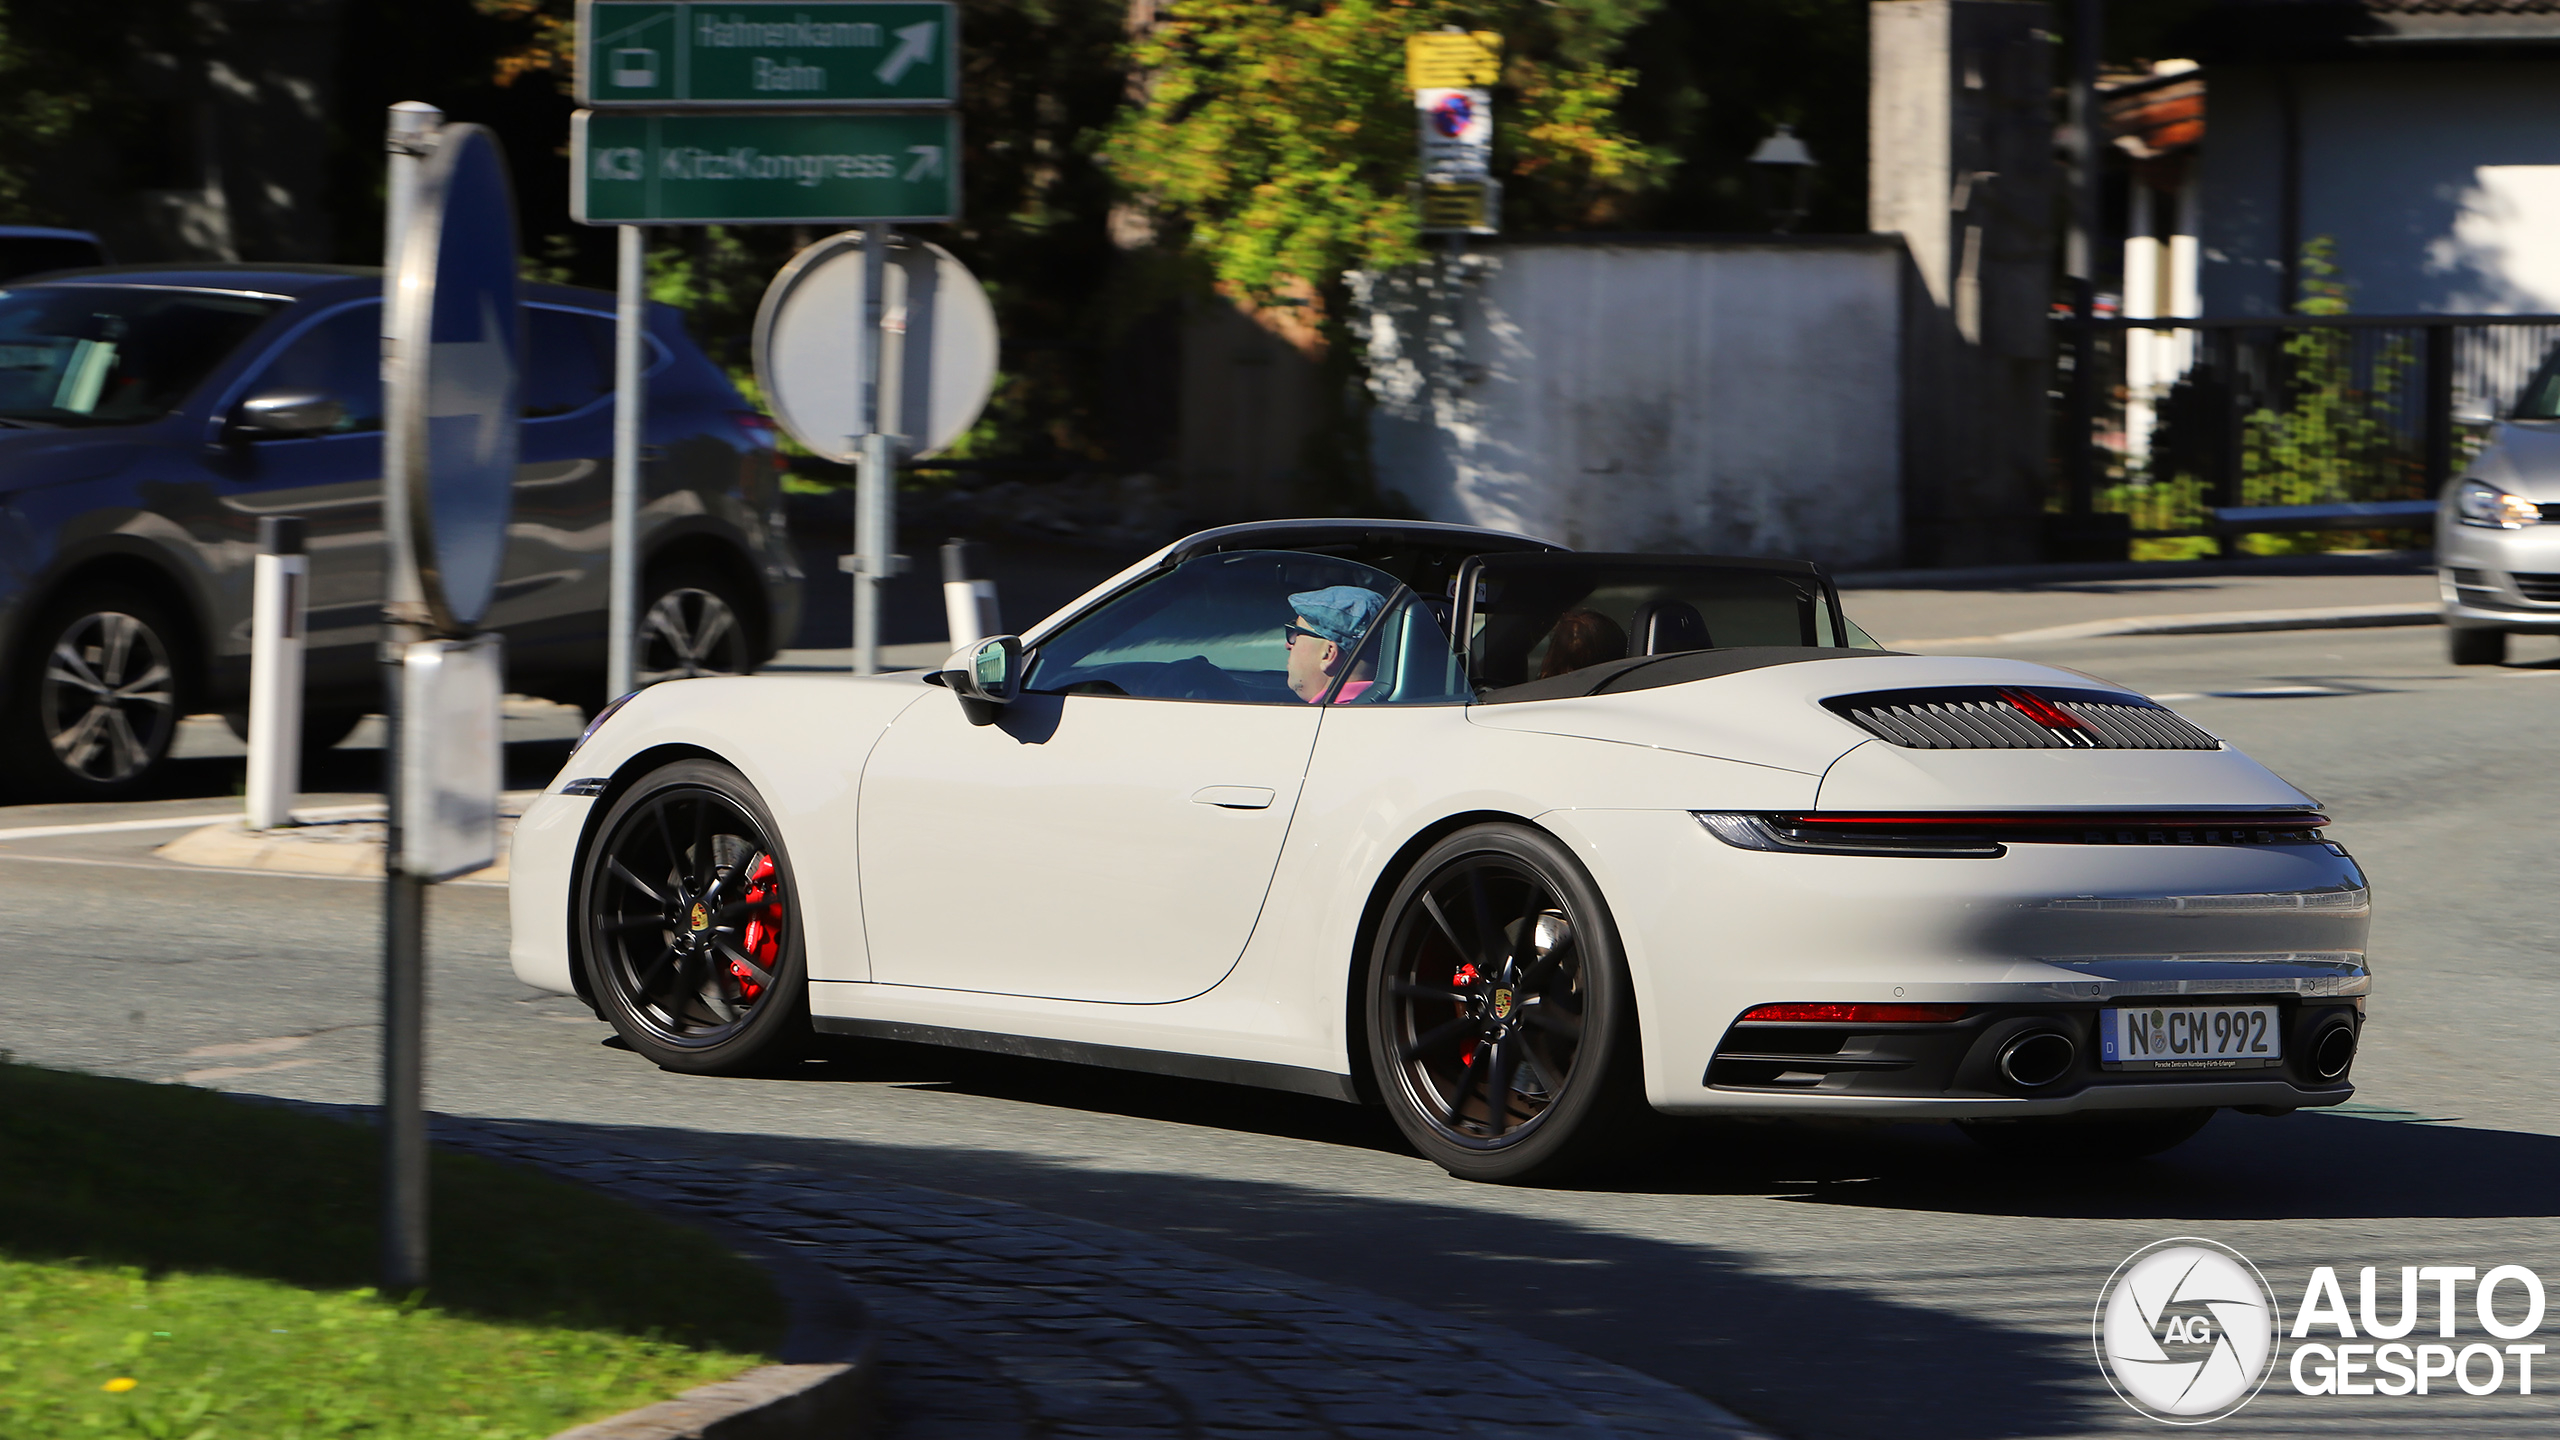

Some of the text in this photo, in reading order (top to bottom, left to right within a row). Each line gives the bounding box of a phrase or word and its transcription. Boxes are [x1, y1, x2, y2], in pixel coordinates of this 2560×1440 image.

[752, 56, 827, 91] Bahn
[593, 146, 896, 187] K3 KitzKongress
[2106, 1041, 2114, 1054] D
[2214, 1011, 2268, 1053] 992
